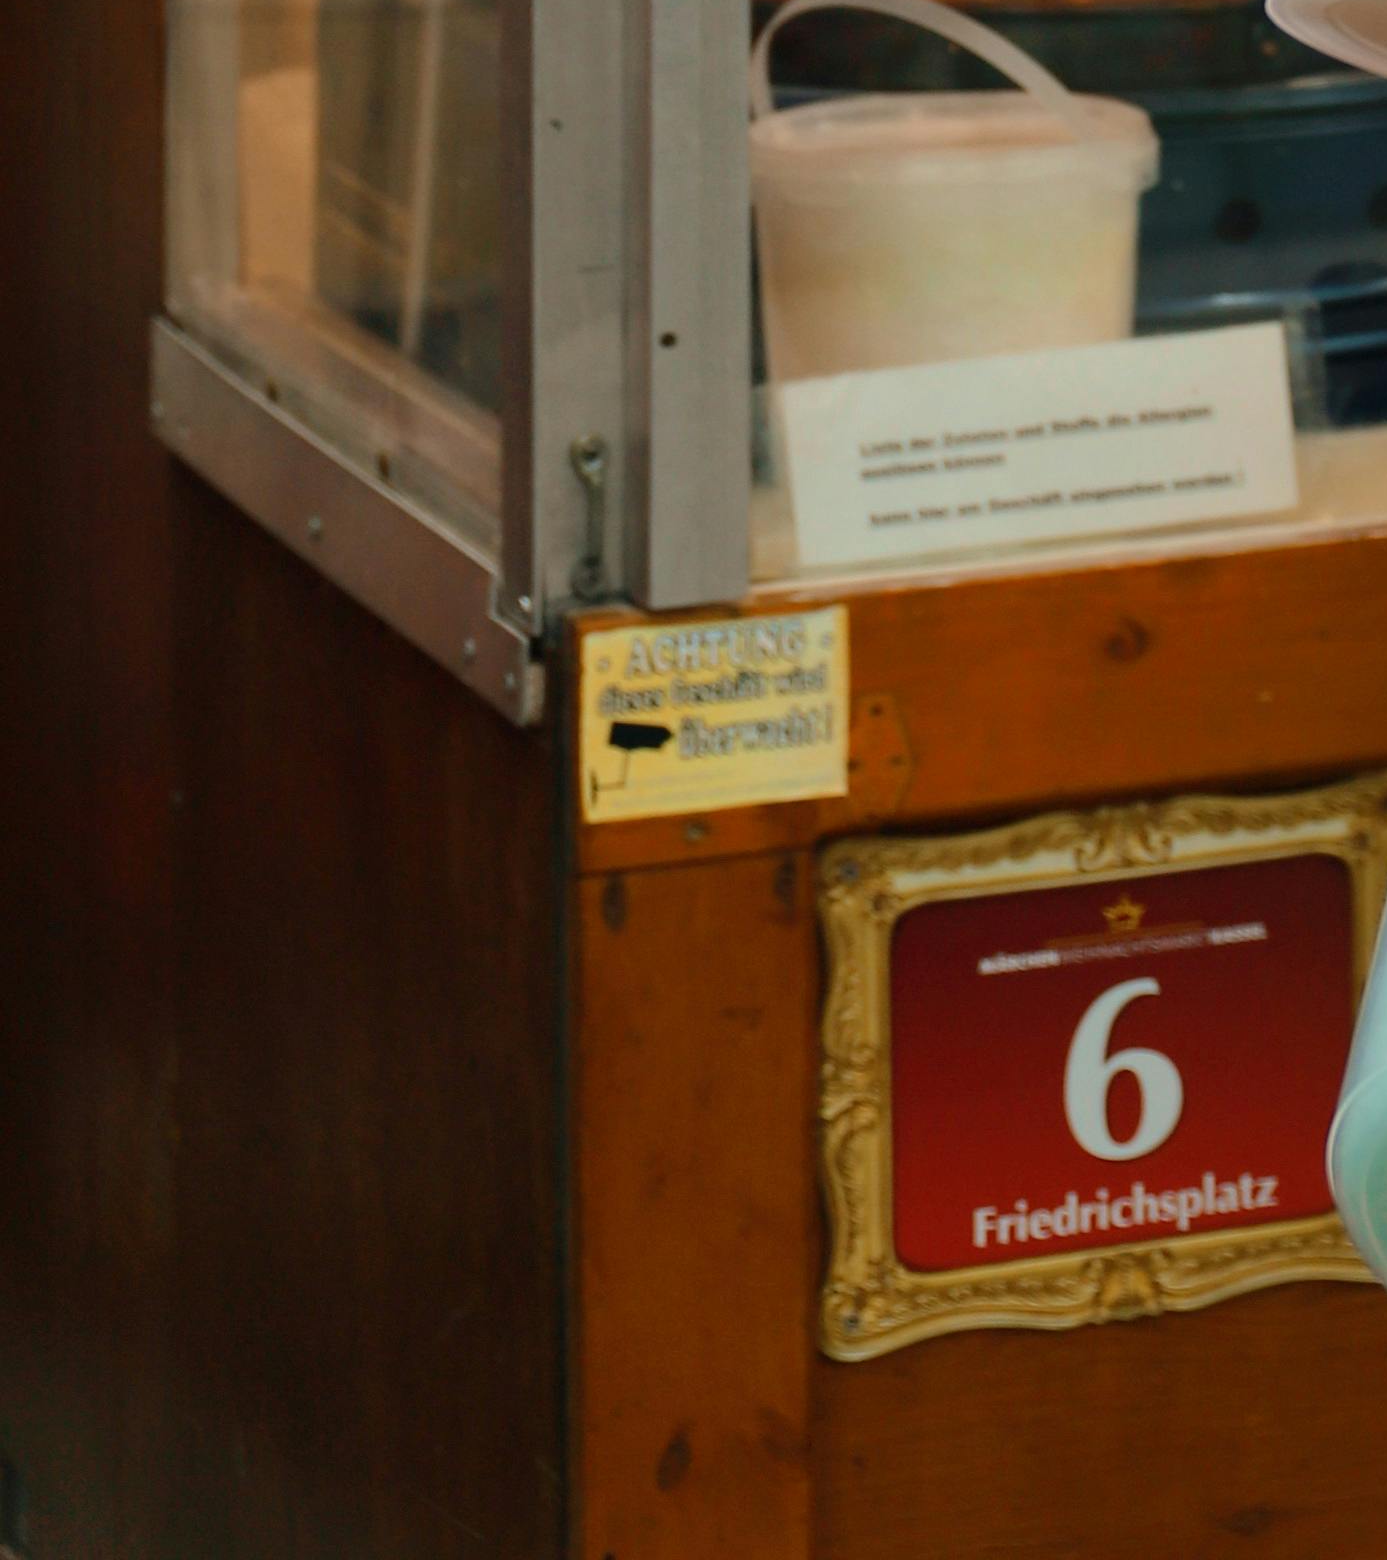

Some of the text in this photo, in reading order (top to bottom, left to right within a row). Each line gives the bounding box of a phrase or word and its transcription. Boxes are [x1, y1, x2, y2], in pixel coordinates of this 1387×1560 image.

[624, 620, 805, 679] ACHTUNG
[1063, 975, 1184, 1161] 6
[972, 1170, 1279, 1248] Friedrichsplatz
